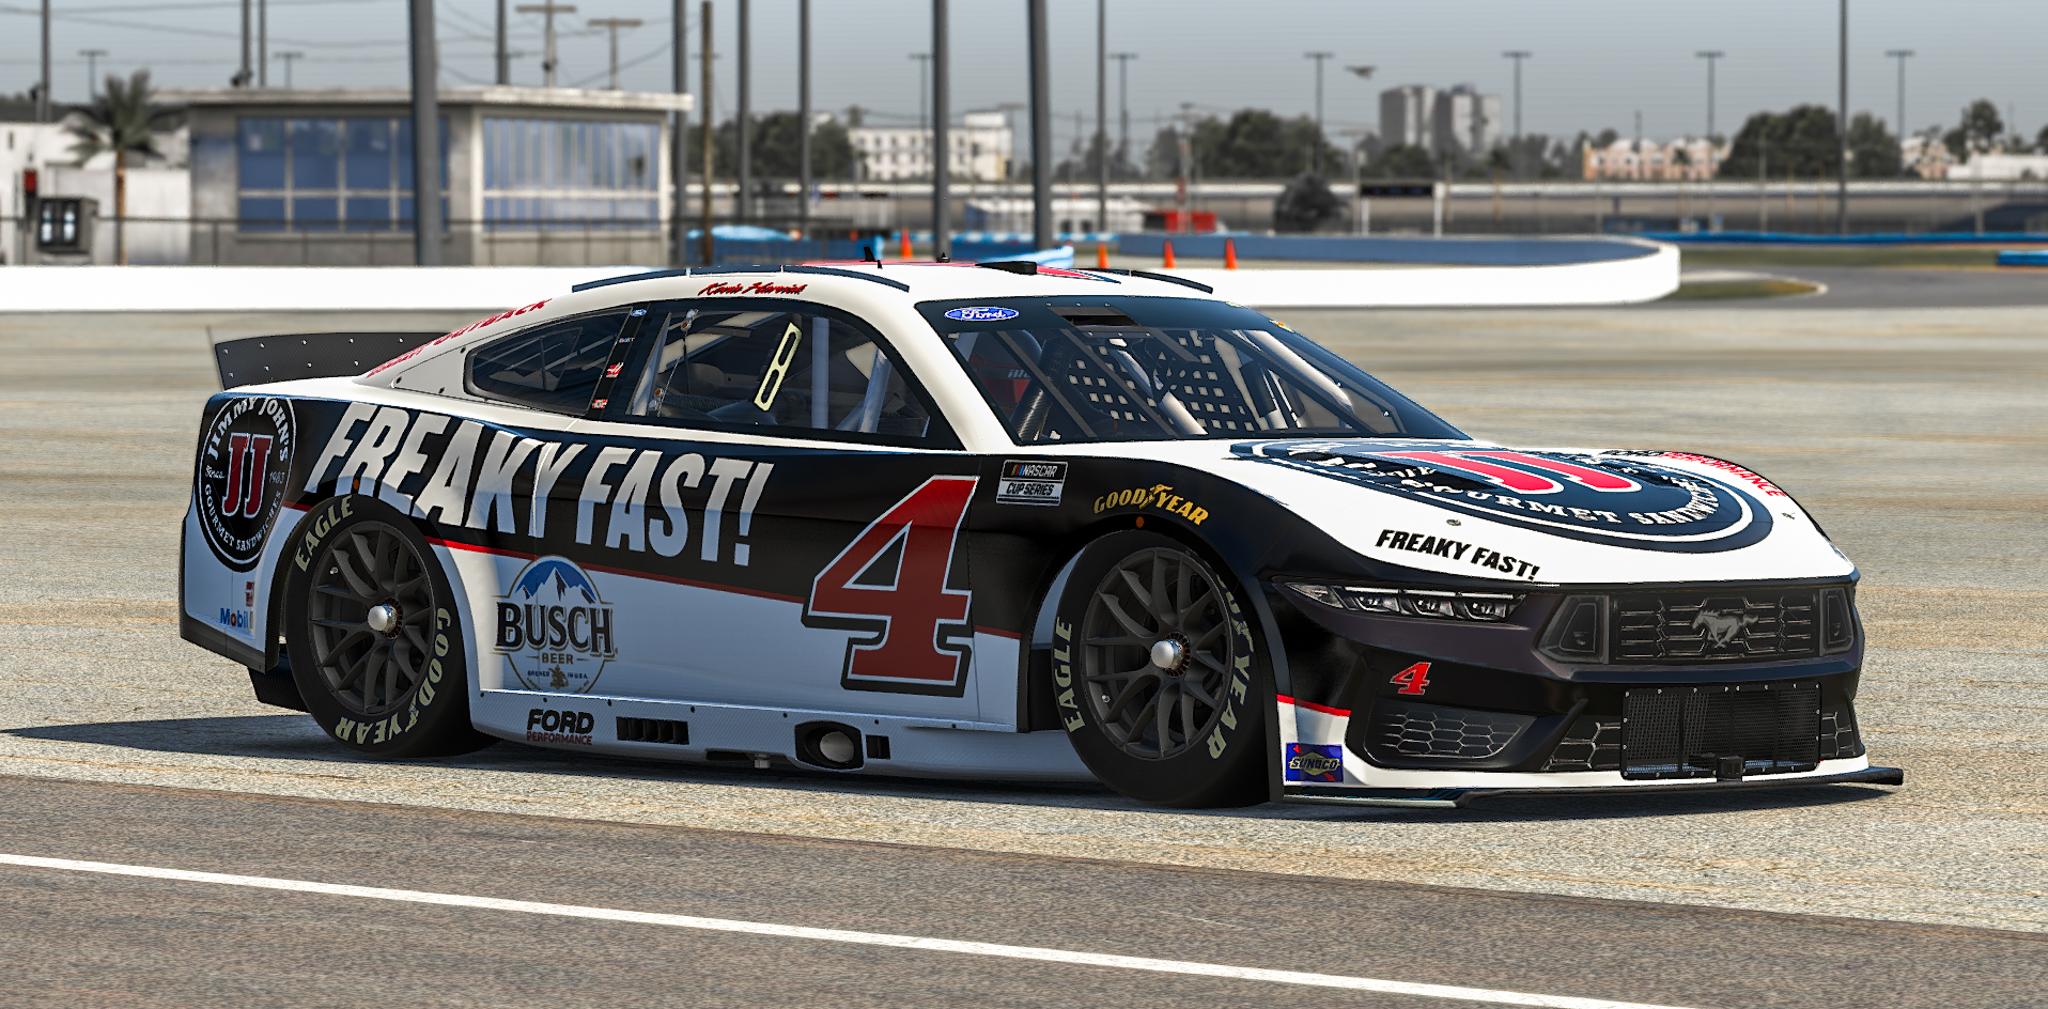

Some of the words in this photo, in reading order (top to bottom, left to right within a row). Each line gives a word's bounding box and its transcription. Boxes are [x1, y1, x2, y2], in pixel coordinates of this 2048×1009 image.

[207, 396, 258, 461] JIMMY
[221, 432, 275, 519] JJ
[304, 402, 587, 538] FREAKY
[575, 446, 775, 567] FAST!
[1006, 482, 1025, 495] CUP
[1023, 483, 1055, 496] SERIES
[1023, 464, 1058, 478] NASCAR
[205, 484, 236, 547] GOURMET
[1093, 484, 1209, 526] GOODYEAR
[294, 494, 354, 573] EAGLE
[1375, 529, 1472, 561] FREAKY
[1470, 547, 1541, 581] FAST!
[802, 475, 981, 698] 4
[494, 601, 615, 658] BUSCH
[334, 607, 451, 745] GOODYEAR
[541, 652, 574, 665] BEER
[1053, 616, 1086, 733] EAGLE
[1388, 661, 1432, 696] 4
[526, 731, 593, 746] PERFORMANCE
[527, 708, 595, 735] FORD
[1289, 756, 1339, 770] SUNOCO
